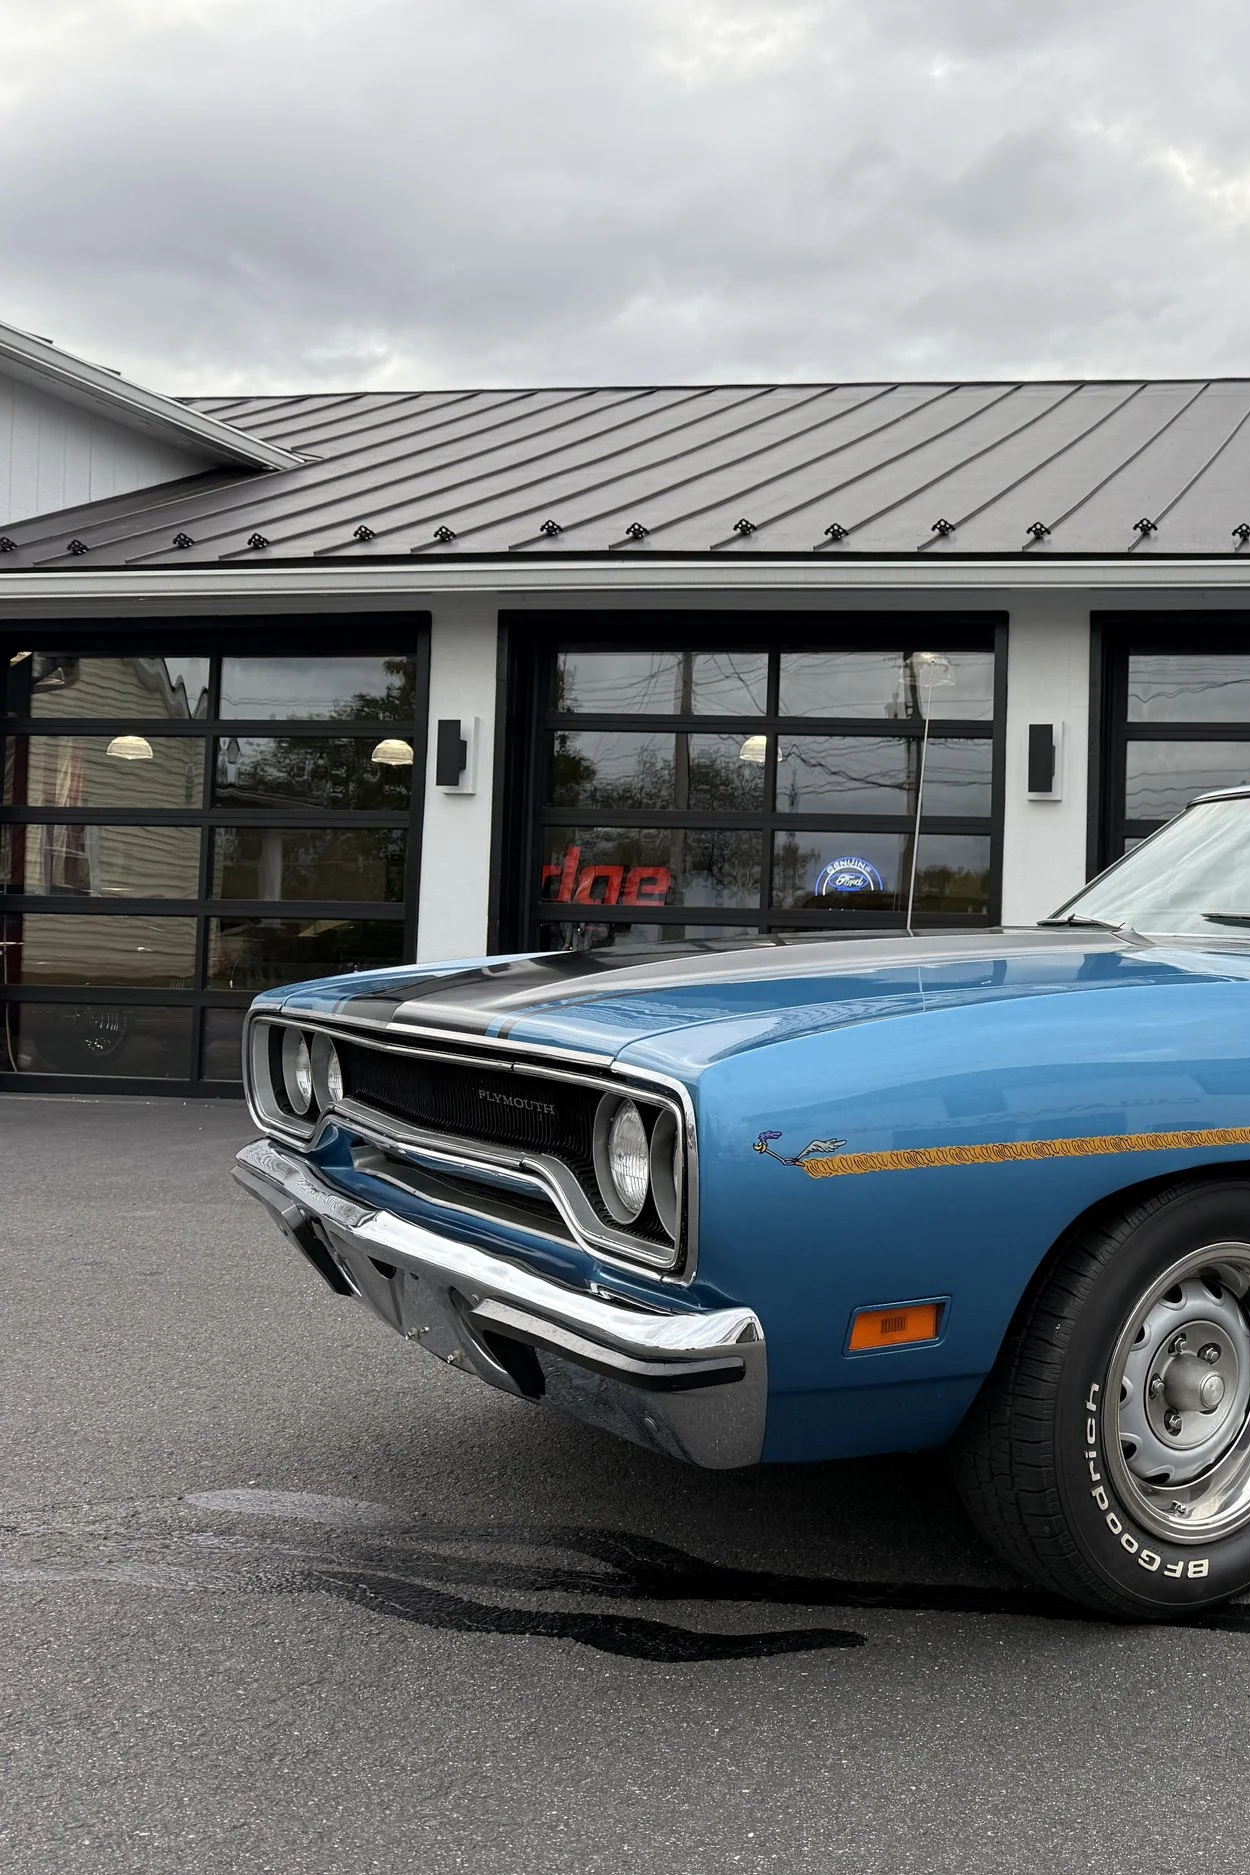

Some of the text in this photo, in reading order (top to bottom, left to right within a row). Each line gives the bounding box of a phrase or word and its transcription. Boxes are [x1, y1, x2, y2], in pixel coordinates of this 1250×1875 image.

[836, 873, 864, 887] Ford
[478, 1089, 556, 1115] PLYMOUTH
[1084, 1383, 1210, 1579] BFGoodrich
